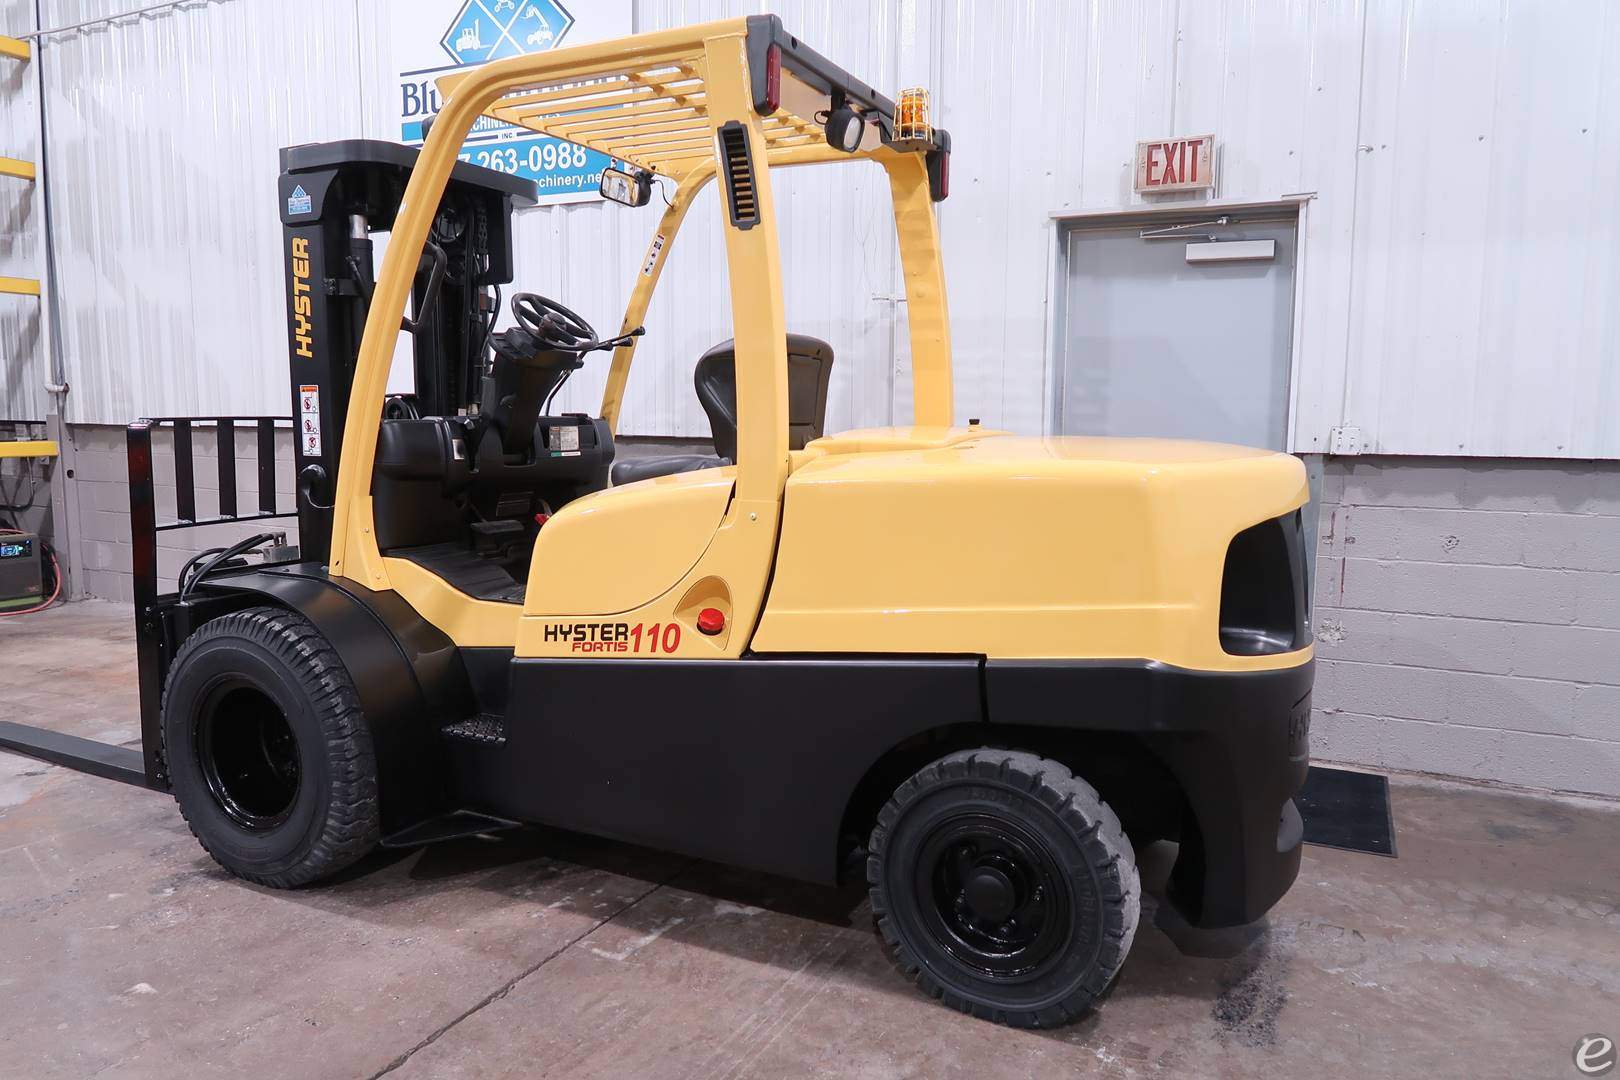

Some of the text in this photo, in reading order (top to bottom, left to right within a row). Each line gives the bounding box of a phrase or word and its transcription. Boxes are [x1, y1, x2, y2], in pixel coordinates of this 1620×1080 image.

[1146, 140, 1203, 186] EXIT
[292, 237, 313, 358] HYSTER
[544, 623, 681, 654] HYSTER 110
[572, 641, 629, 652] FORTIS
